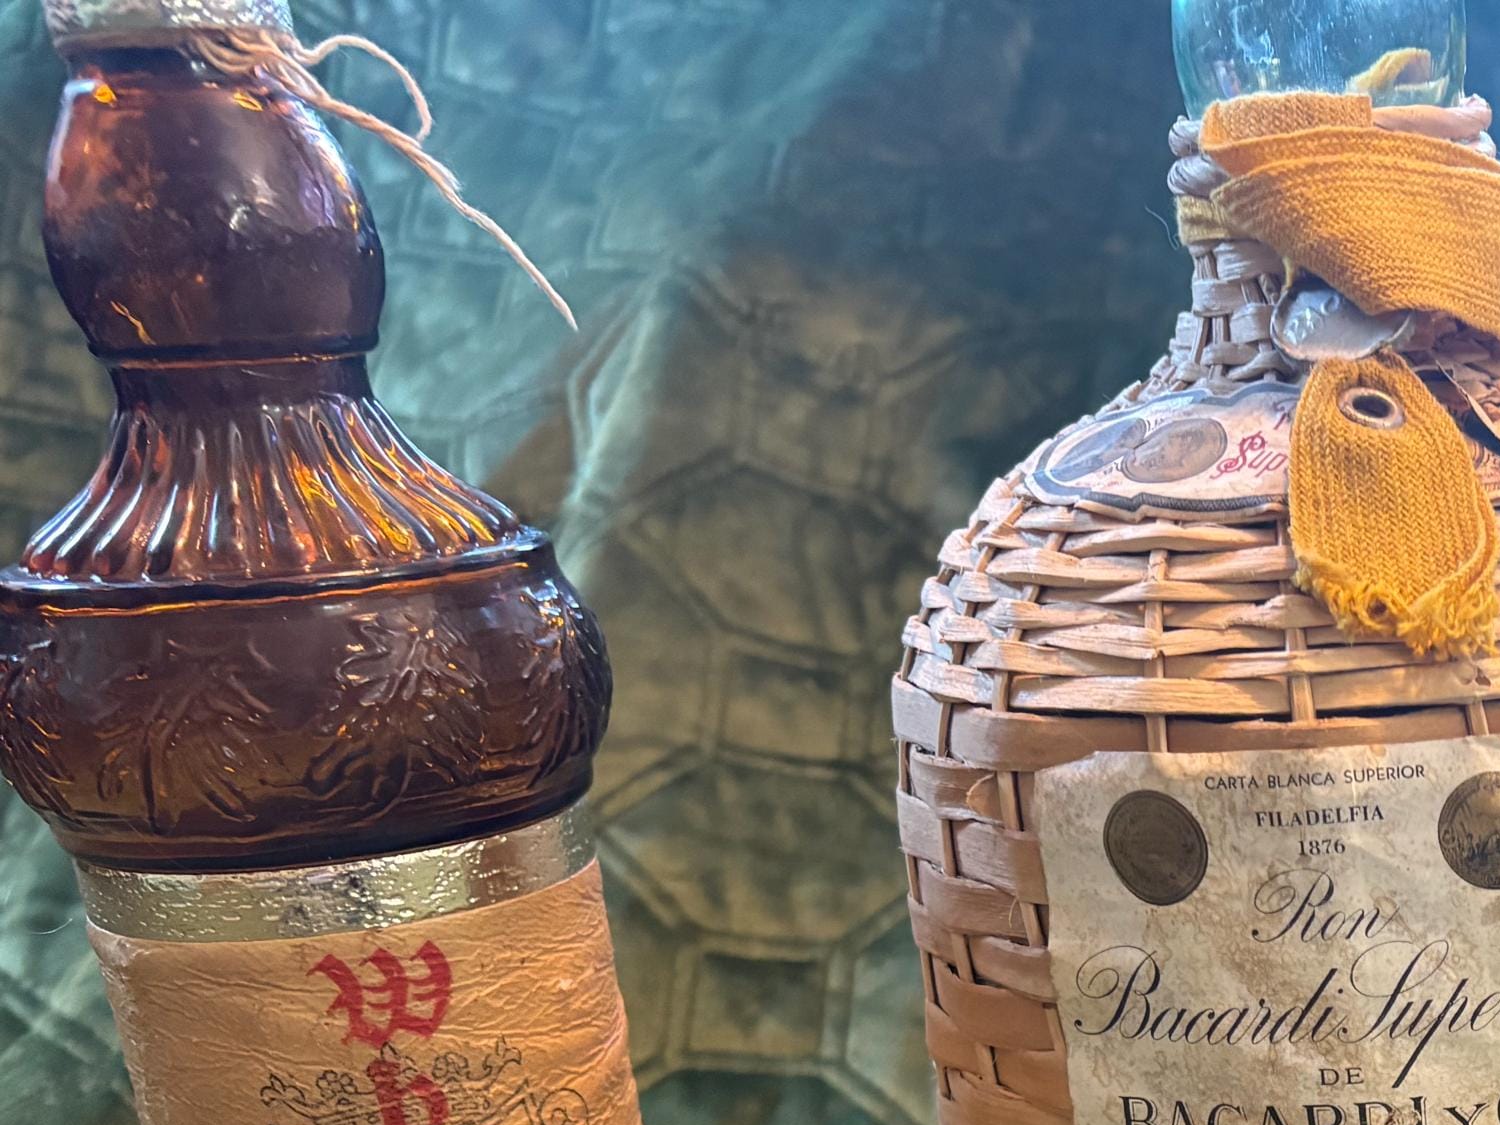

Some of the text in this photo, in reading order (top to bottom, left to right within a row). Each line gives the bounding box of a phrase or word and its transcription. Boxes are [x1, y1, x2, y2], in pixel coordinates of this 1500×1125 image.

[1204, 764, 1425, 791] CARTA BLANCA SUPERIOR
[1255, 805, 1384, 828] FILADELFIA
[1297, 839, 1346, 857] 1876
[1252, 867, 1400, 943] Ron
[1073, 945, 1345, 1046] Bacardi
[1319, 1067, 1365, 1087] DE
